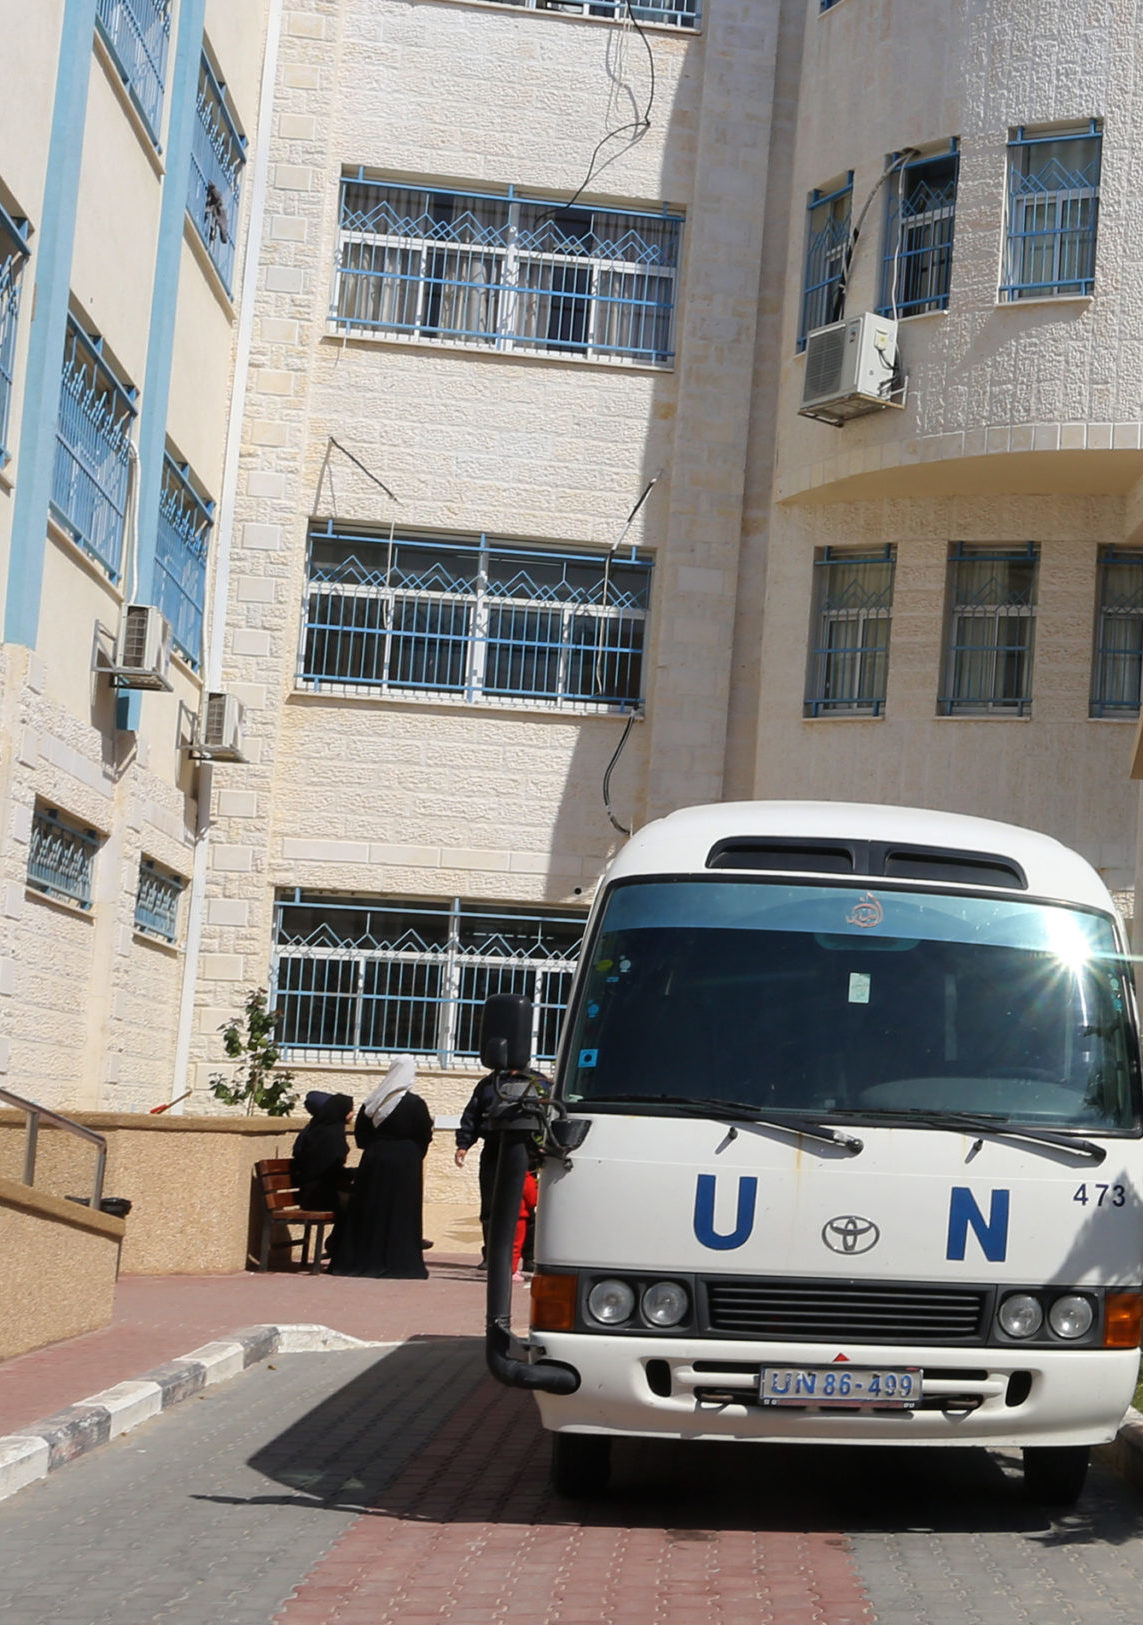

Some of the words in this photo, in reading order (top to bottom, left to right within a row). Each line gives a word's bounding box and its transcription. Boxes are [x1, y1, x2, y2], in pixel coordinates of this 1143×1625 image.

[1073, 1183, 1127, 1207] 473
[771, 1372, 816, 1395] UN
[823, 1373, 913, 1397] 86-499
